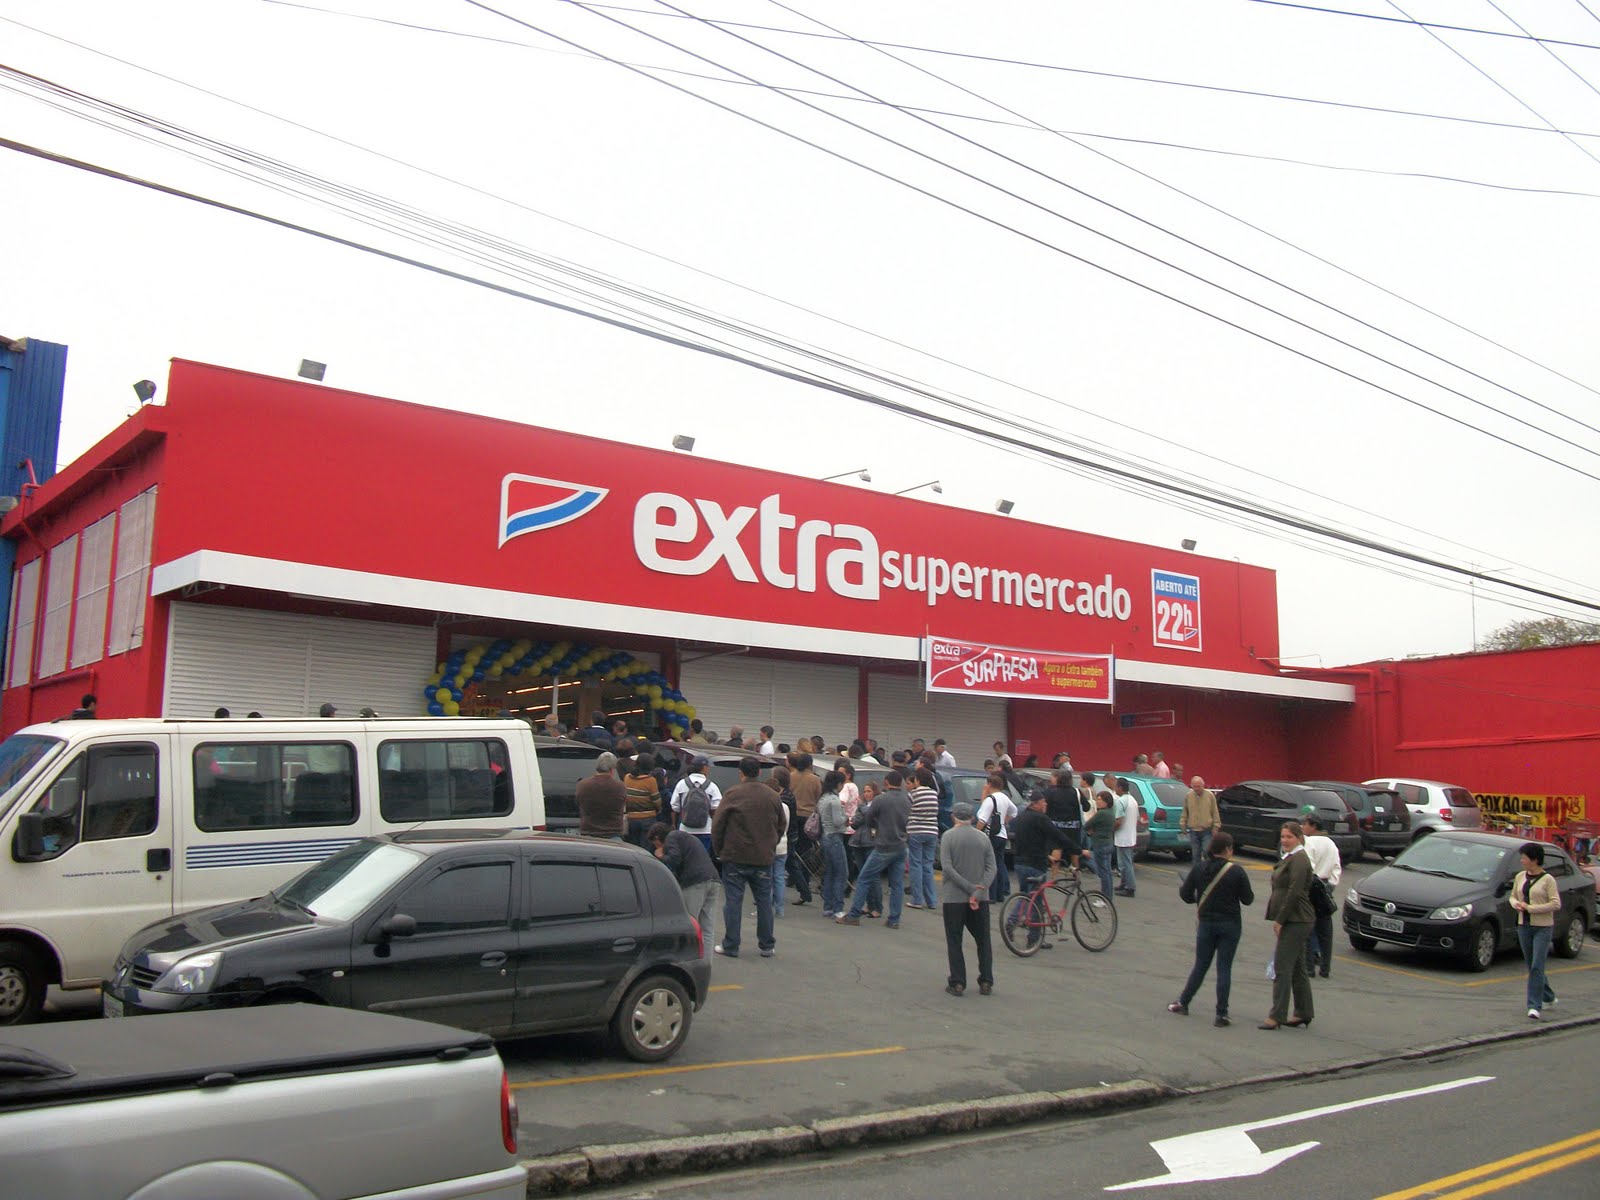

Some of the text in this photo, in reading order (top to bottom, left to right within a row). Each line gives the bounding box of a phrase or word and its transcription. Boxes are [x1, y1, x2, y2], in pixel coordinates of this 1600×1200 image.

[633, 492, 1132, 621] extra supermercado
[1155, 579, 1197, 597] ABERTO ATÉ
[1157, 600, 1193, 642] 22h
[933, 643, 960, 656] extra
[962, 652, 1039, 687] SURPRESA
[1043, 660, 1104, 677] Agora o Extra também
[1051, 675, 1097, 688] é supermercado
[1521, 799, 1543, 813] MOLE
